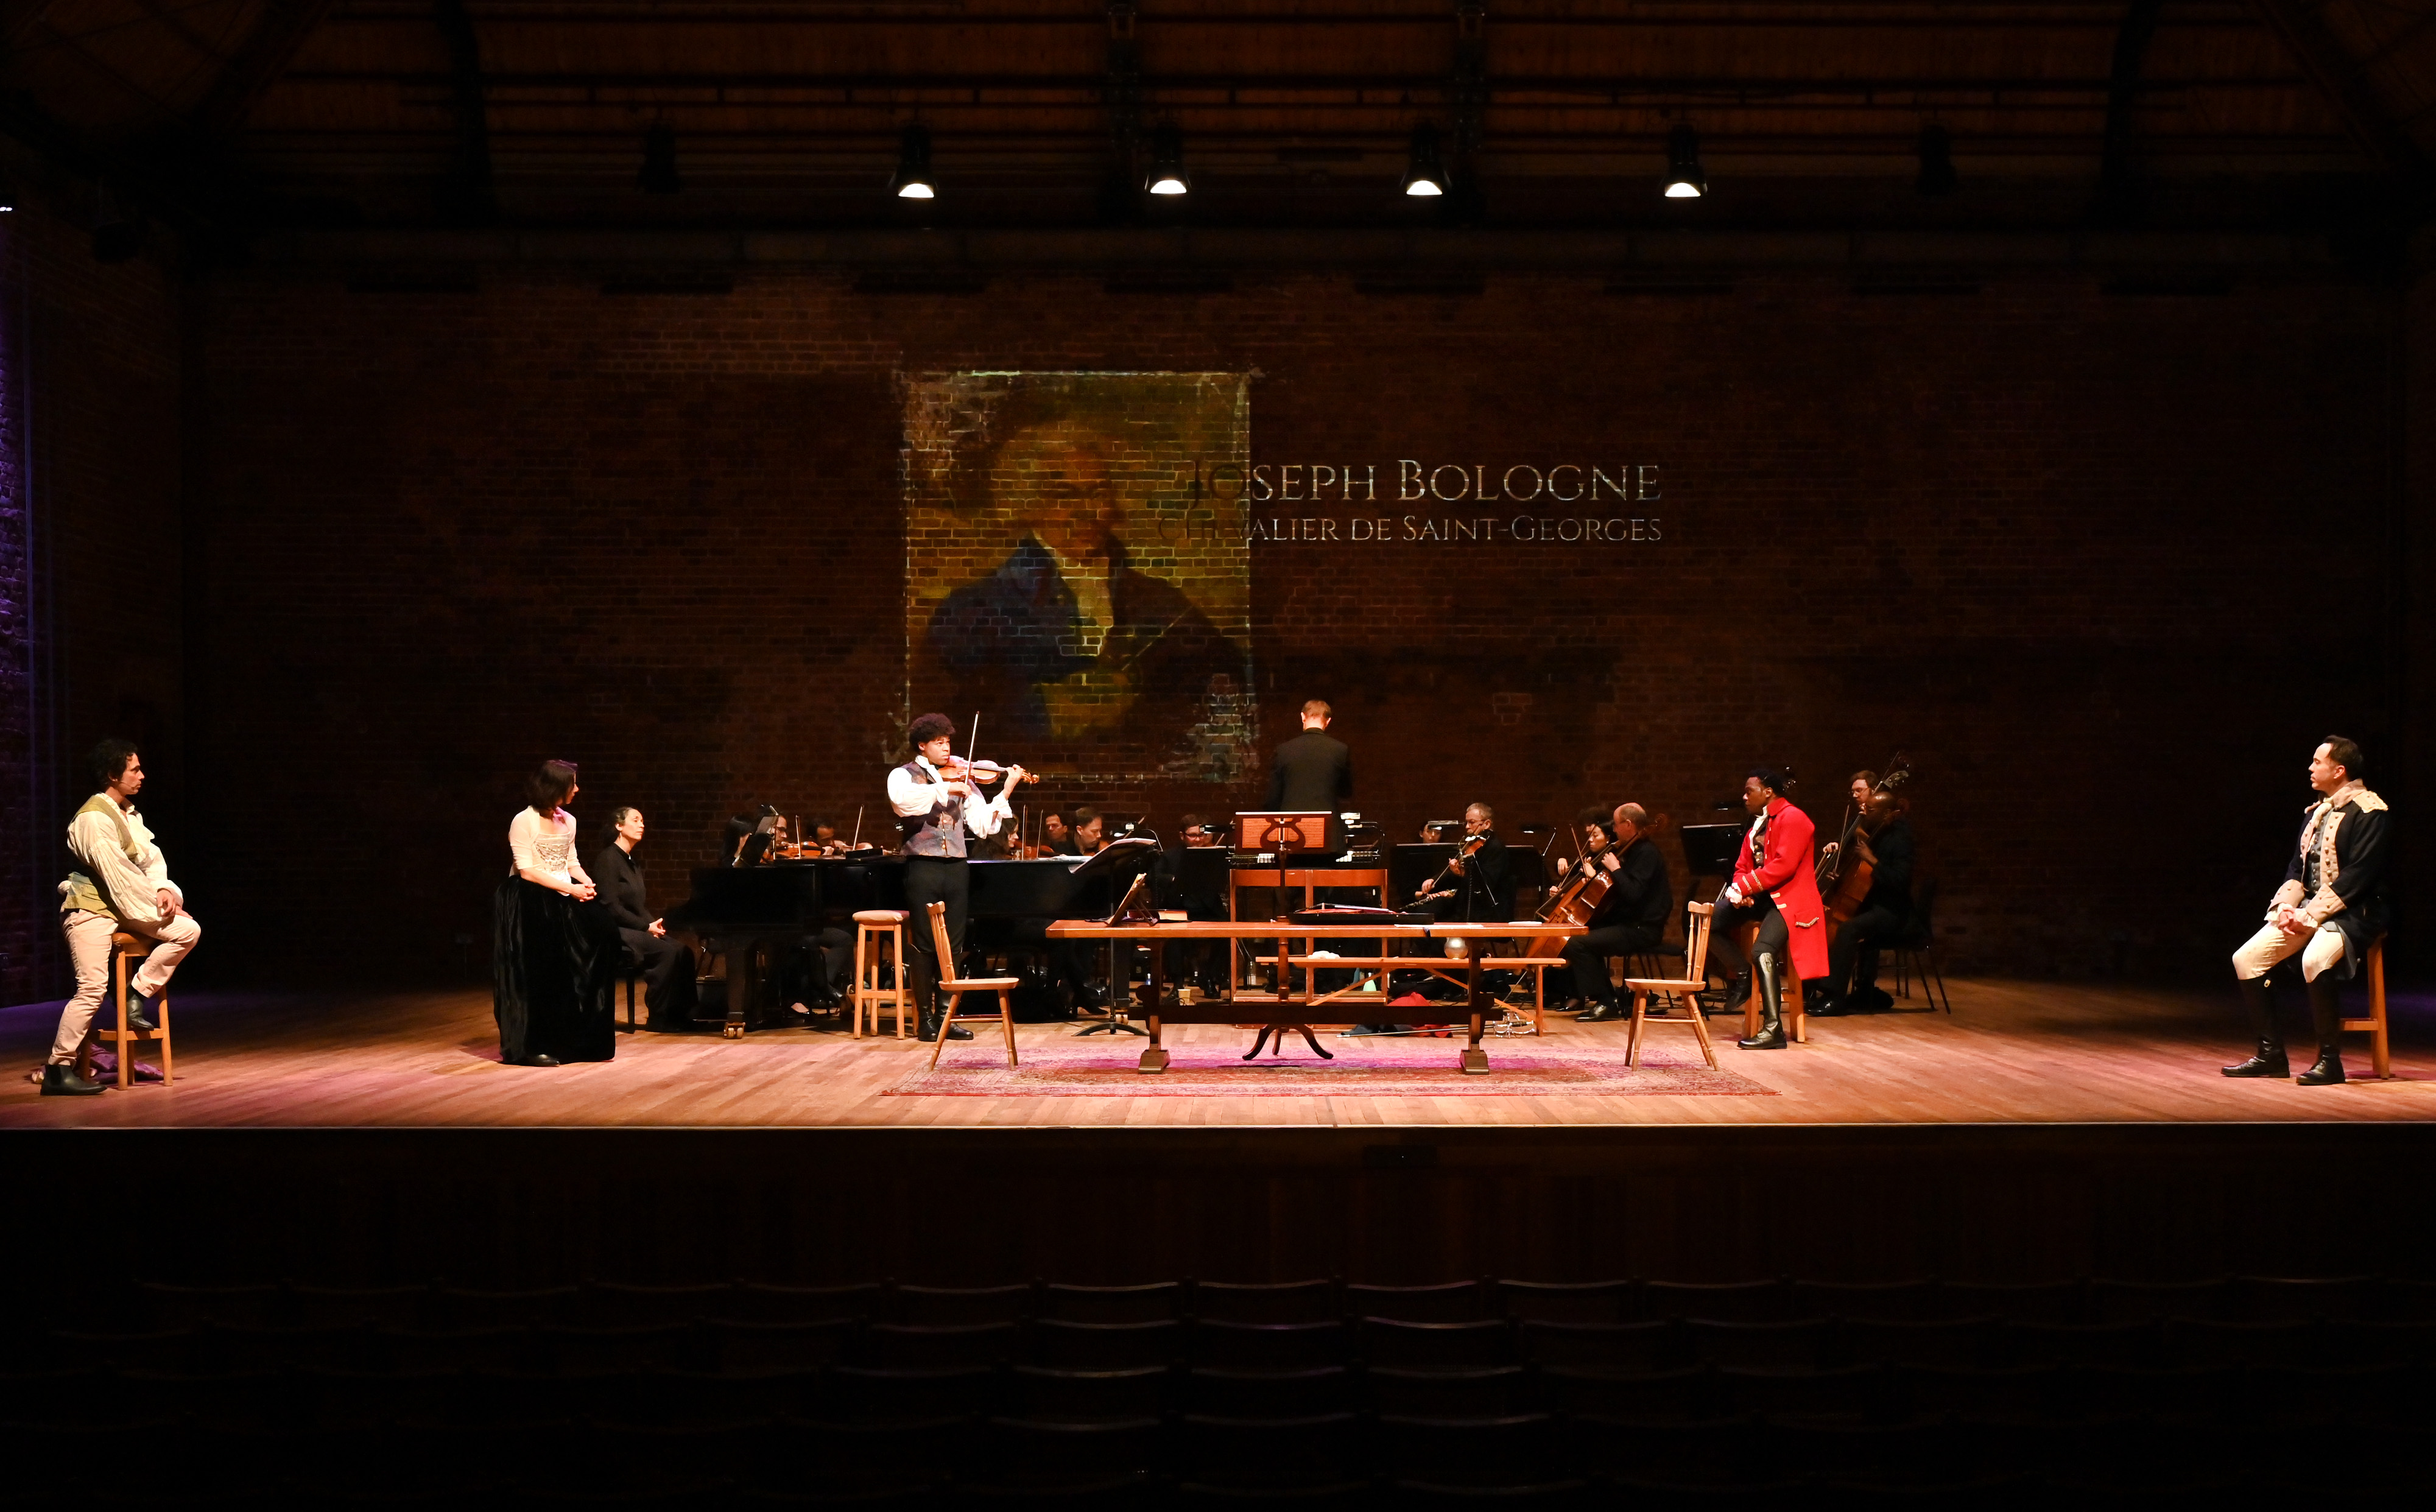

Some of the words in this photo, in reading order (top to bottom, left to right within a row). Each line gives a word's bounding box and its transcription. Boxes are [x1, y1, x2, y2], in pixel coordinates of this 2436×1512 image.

[1188, 459, 1377, 510] JOSEPH
[1396, 459, 1662, 501] BOLOGNE
[1351, 518, 1392, 541] DE
[1403, 515, 1662, 541] SAINT-GEORGES
